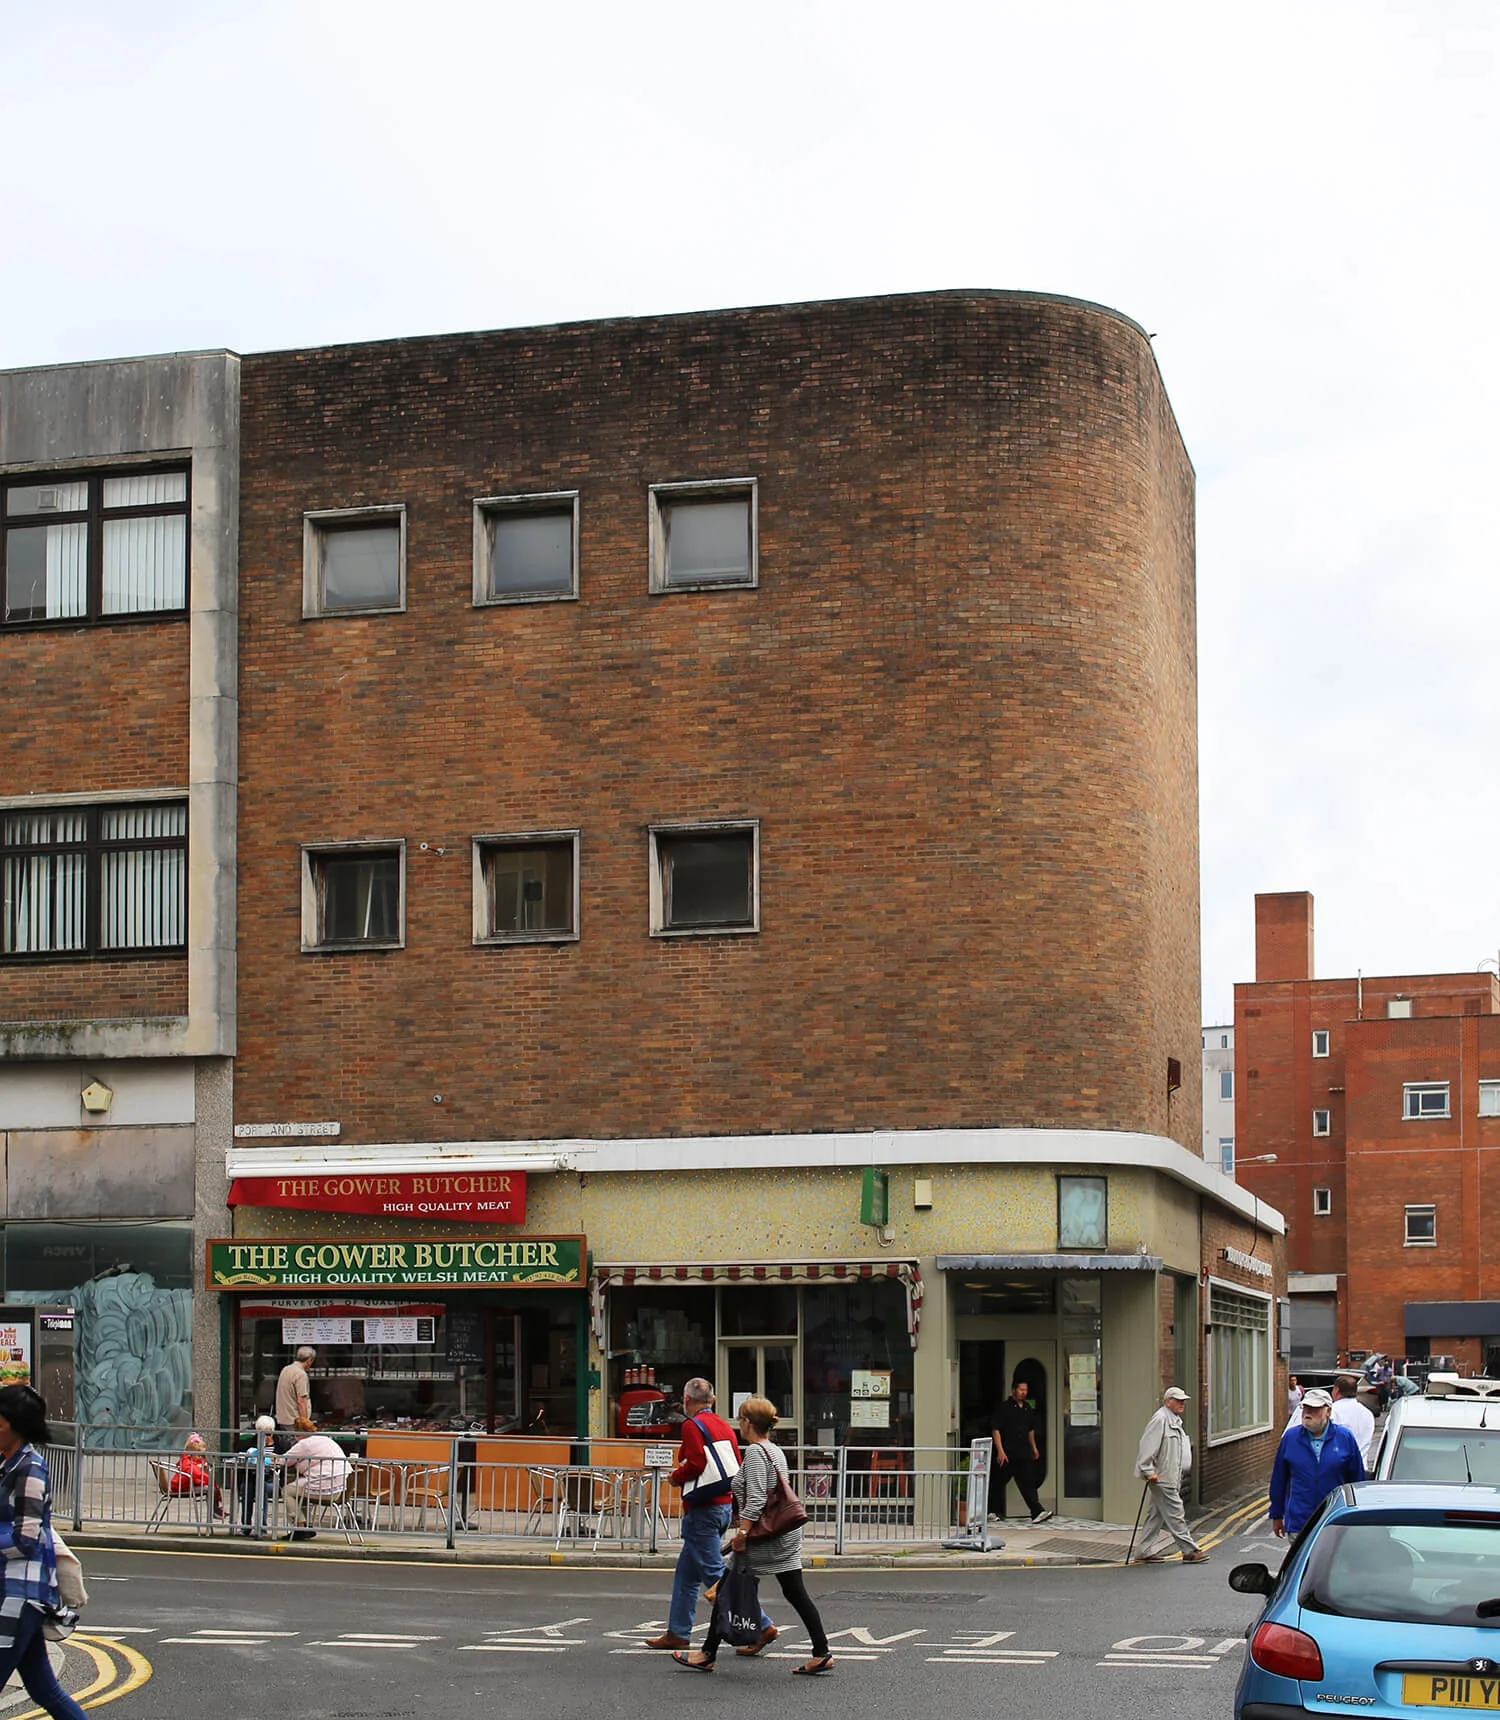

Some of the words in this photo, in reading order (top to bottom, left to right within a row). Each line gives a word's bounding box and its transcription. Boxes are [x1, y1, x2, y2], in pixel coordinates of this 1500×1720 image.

[239, 1125, 292, 1136] PORAND
[297, 1123, 336, 1135] STREET
[277, 1179, 320, 1196] THE
[323, 1178, 402, 1196] GOWER
[411, 1175, 512, 1194] BUTCHER
[383, 1203, 414, 1212] HIGH
[418, 1202, 472, 1213] QUALITY
[477, 1201, 511, 1210] MEAT
[228, 1245, 289, 1270] THE
[295, 1244, 408, 1270] GOWER
[413, 1242, 559, 1268] BUTCHER
[282, 1273, 321, 1284] HIGH
[327, 1273, 397, 1284] QUALITY
[401, 1272, 457, 1283] WELSH
[463, 1271, 508, 1282] MEAT
[0, 1338, 17, 1347] EALS
[1480, 1679, 1500, 1704] Y
[1316, 1693, 1376, 1705] PEUGEOT
